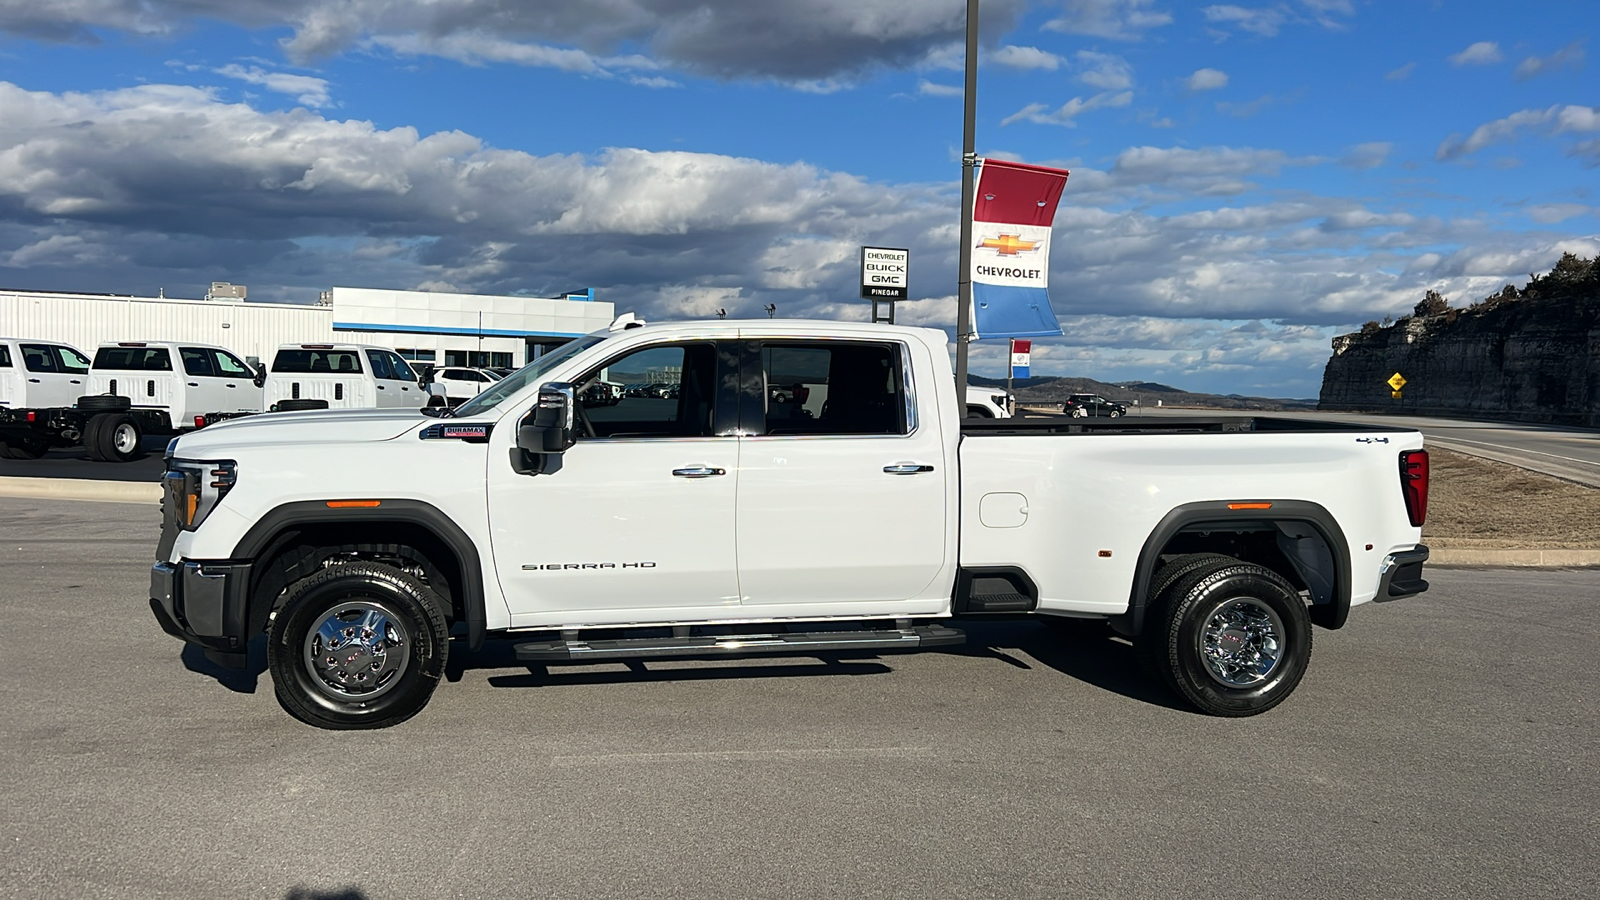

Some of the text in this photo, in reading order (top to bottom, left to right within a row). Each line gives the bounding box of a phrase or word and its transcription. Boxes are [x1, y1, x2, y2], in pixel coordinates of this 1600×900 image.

[867, 252, 905, 261] CHEVROLET
[866, 263, 905, 272] BUICK
[976, 265, 1041, 279] CHEVROLET
[871, 275, 900, 284] GMC
[871, 288, 899, 297] PINEGAR
[521, 561, 657, 571] SIERRA HD
